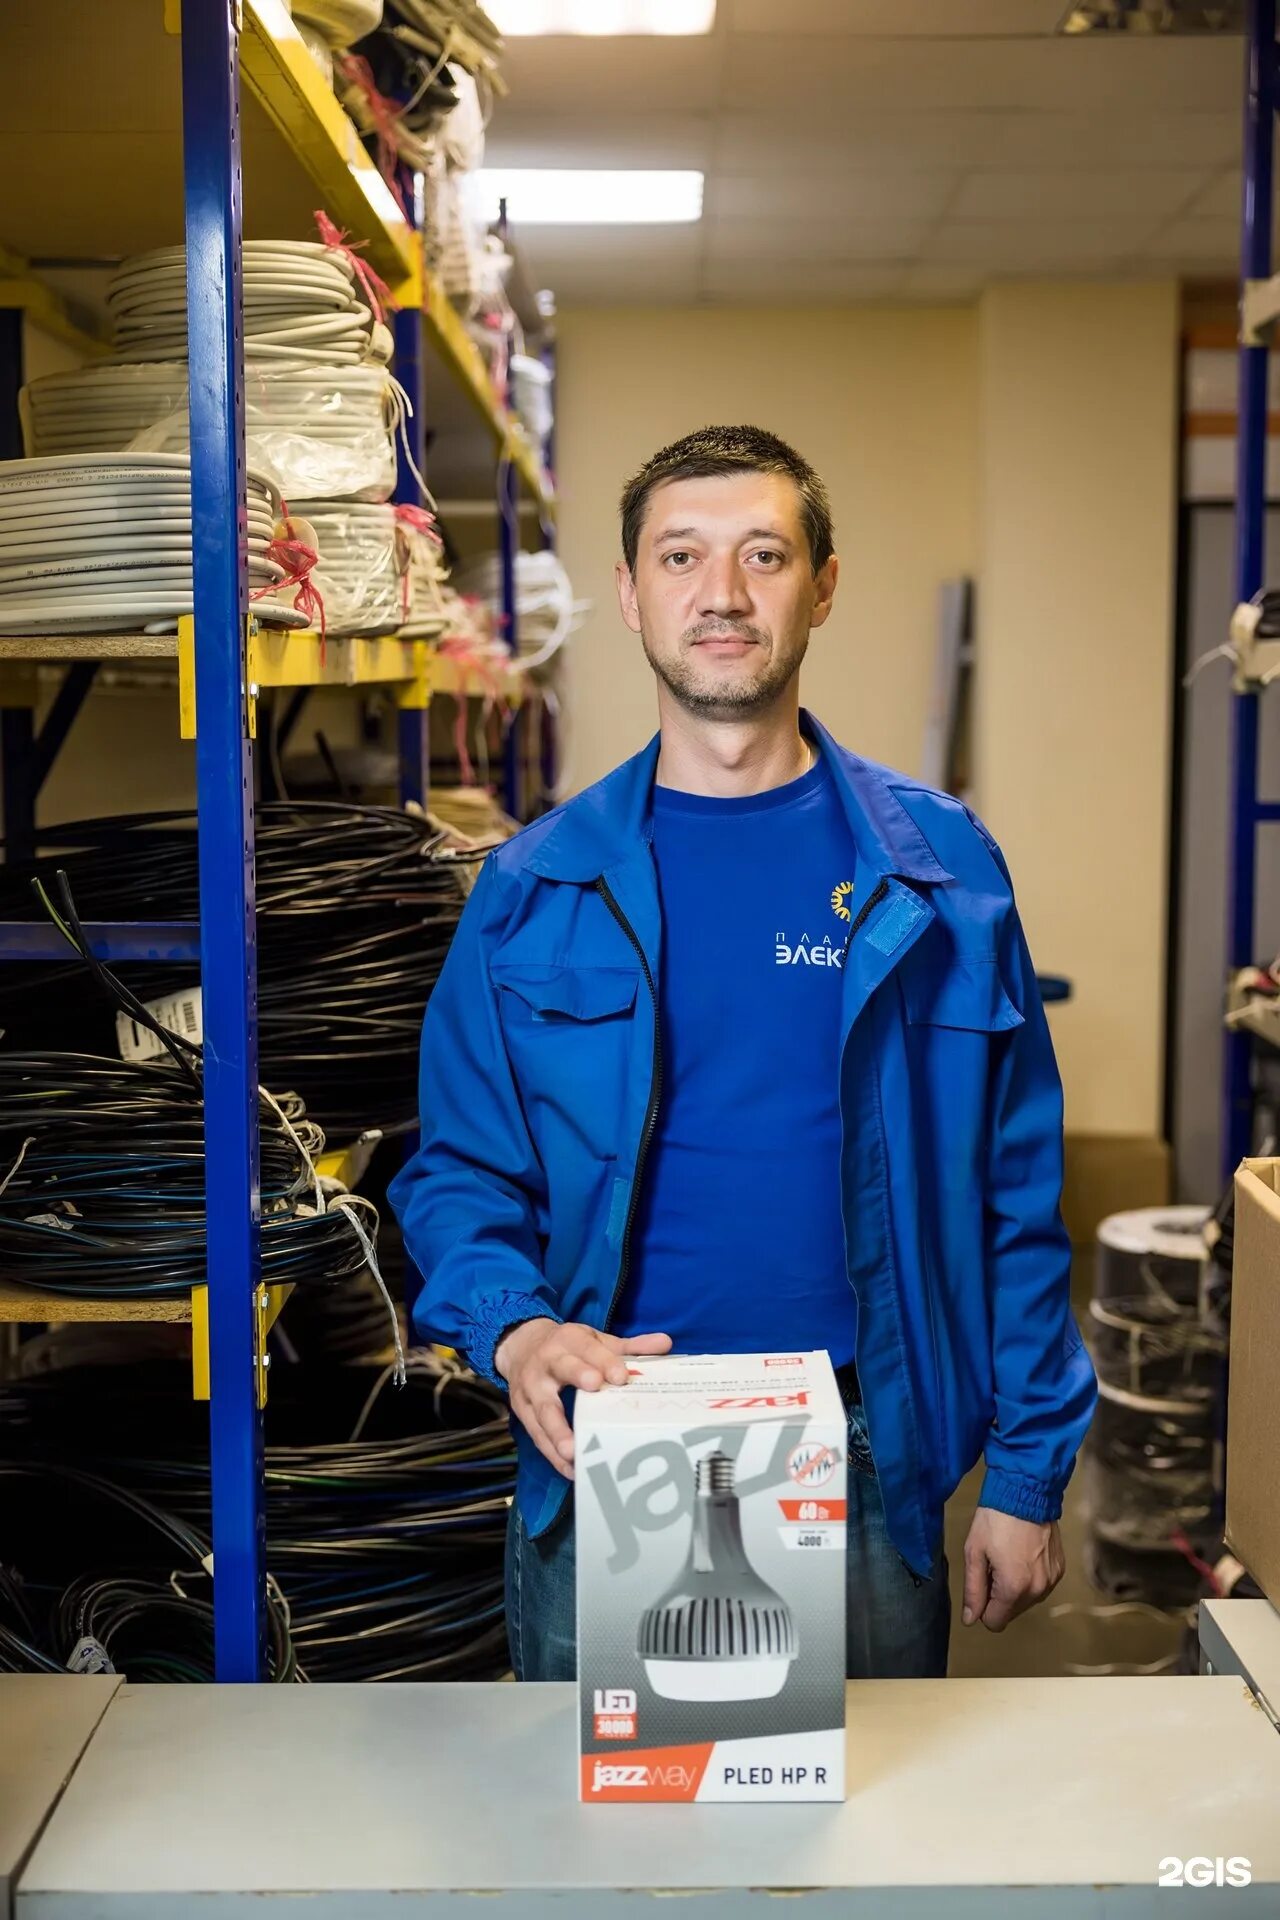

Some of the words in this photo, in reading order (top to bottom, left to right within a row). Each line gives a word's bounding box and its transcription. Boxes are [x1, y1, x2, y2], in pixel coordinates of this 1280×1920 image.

[776, 932, 848, 946] ПЛА
[775, 944, 845, 968] ЭЛЕК
[594, 1689, 637, 1714] LED
[591, 1760, 697, 1792] jazzway
[724, 1767, 773, 1785] PLED
[782, 1767, 807, 1785] HP
[816, 1766, 827, 1784] R
